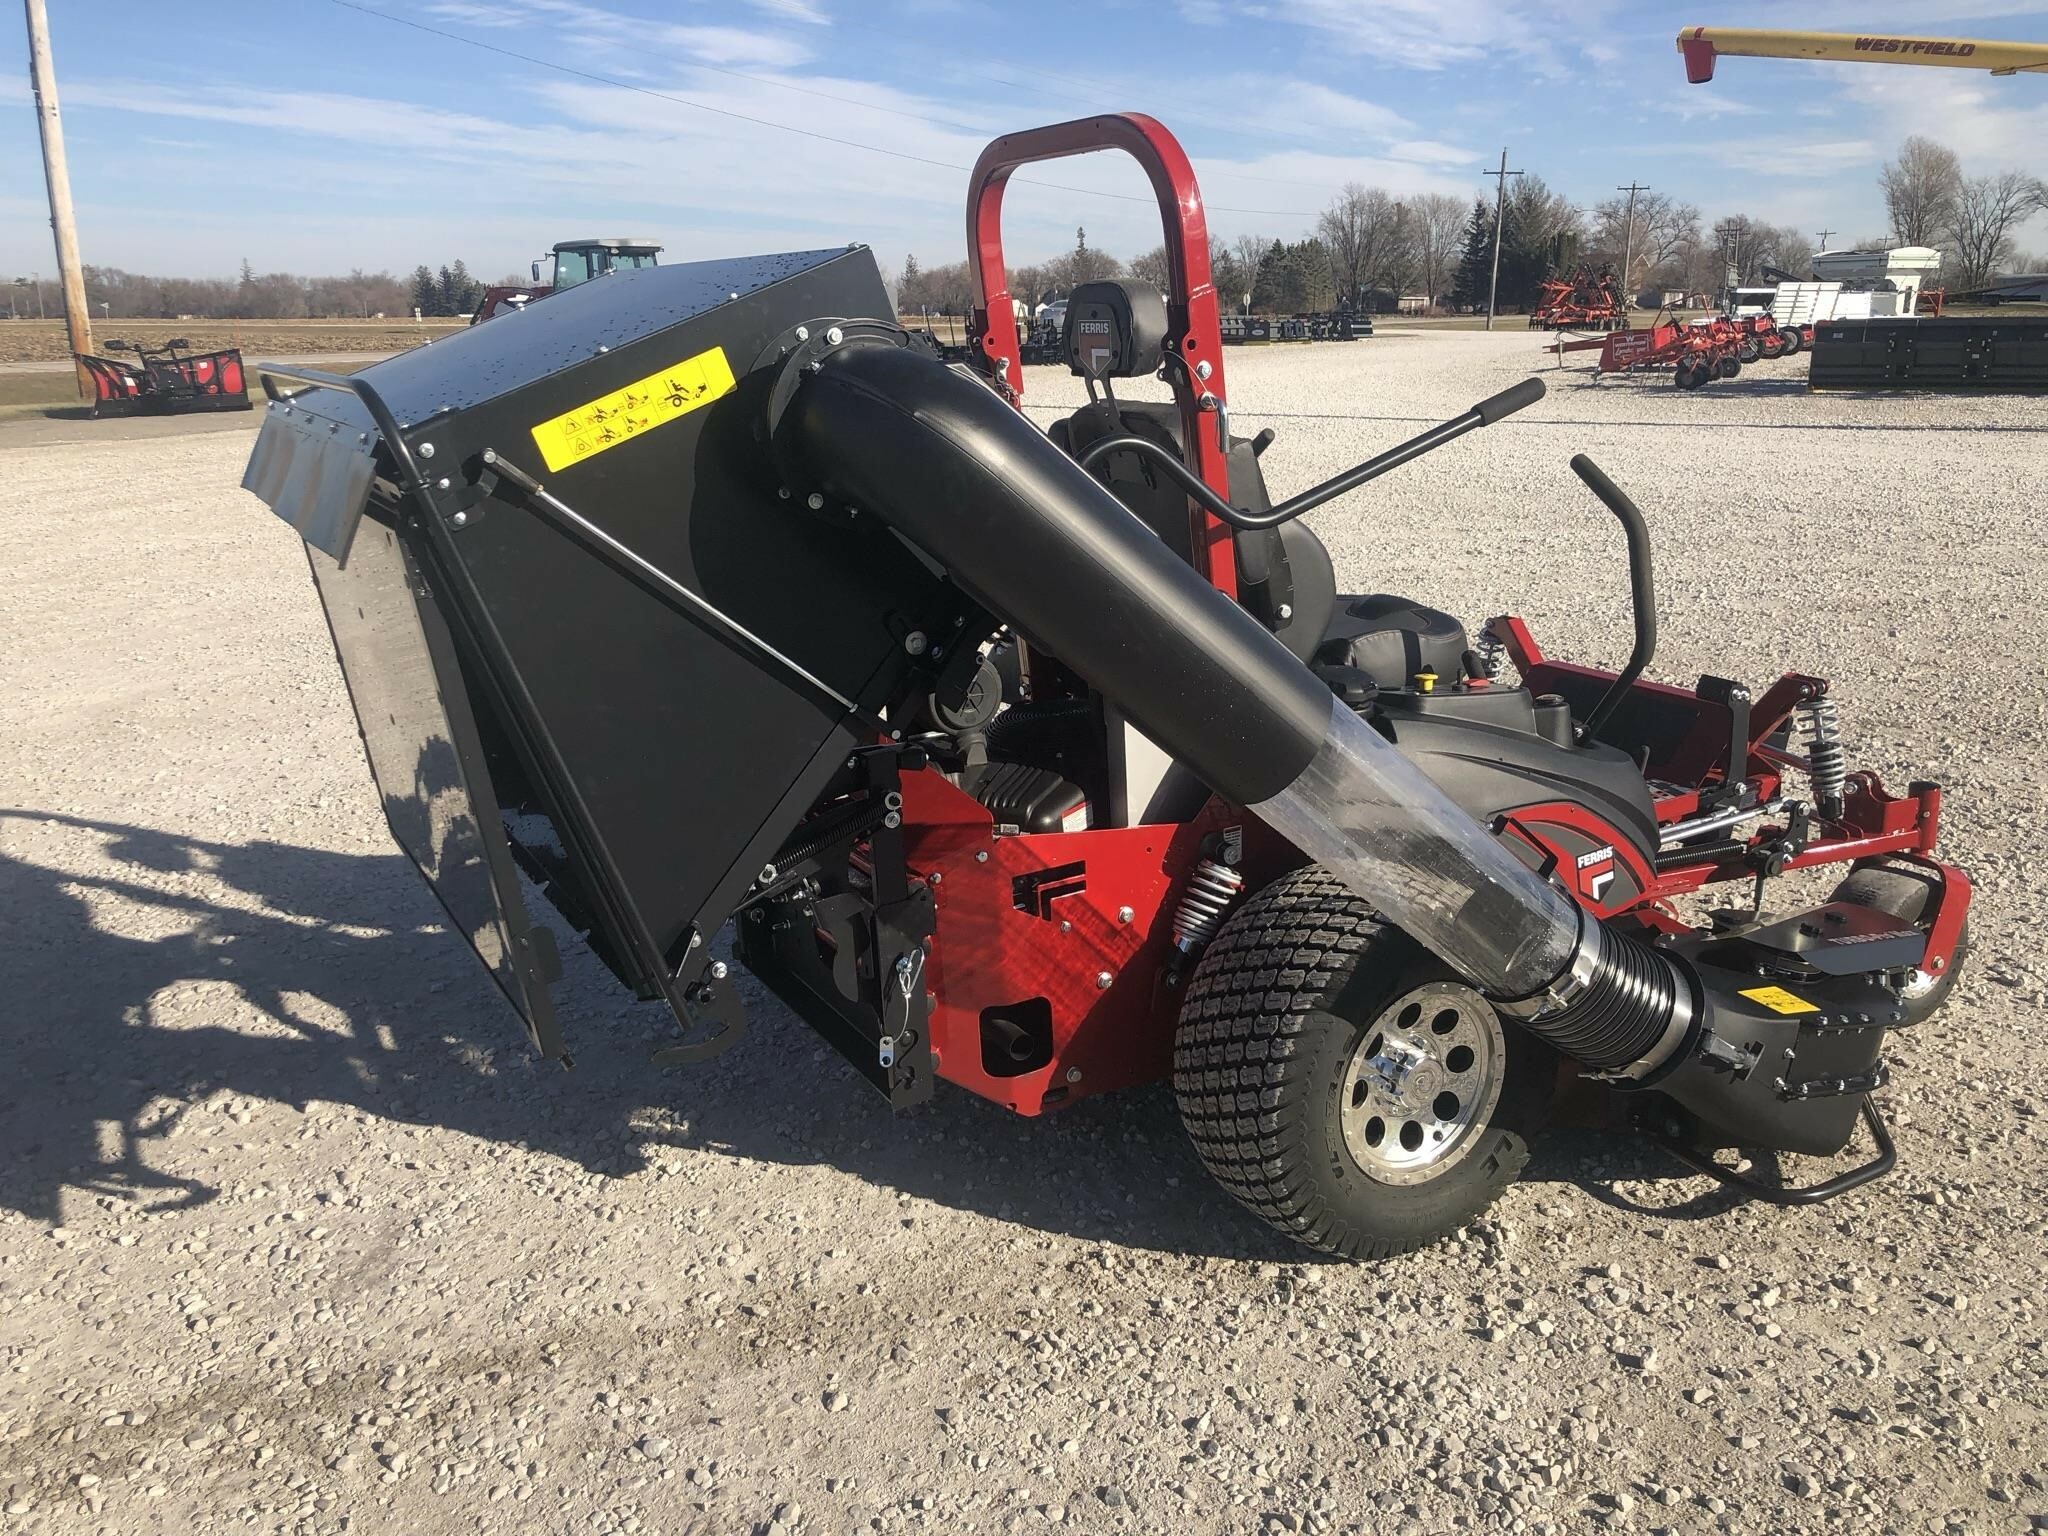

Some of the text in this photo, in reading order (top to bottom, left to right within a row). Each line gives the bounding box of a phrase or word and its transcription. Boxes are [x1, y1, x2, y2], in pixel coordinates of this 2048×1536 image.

[1855, 37, 1976, 57] WESTFIELD
[1080, 322, 1109, 334] FERRIS
[1577, 845, 1614, 869] FERRIS
